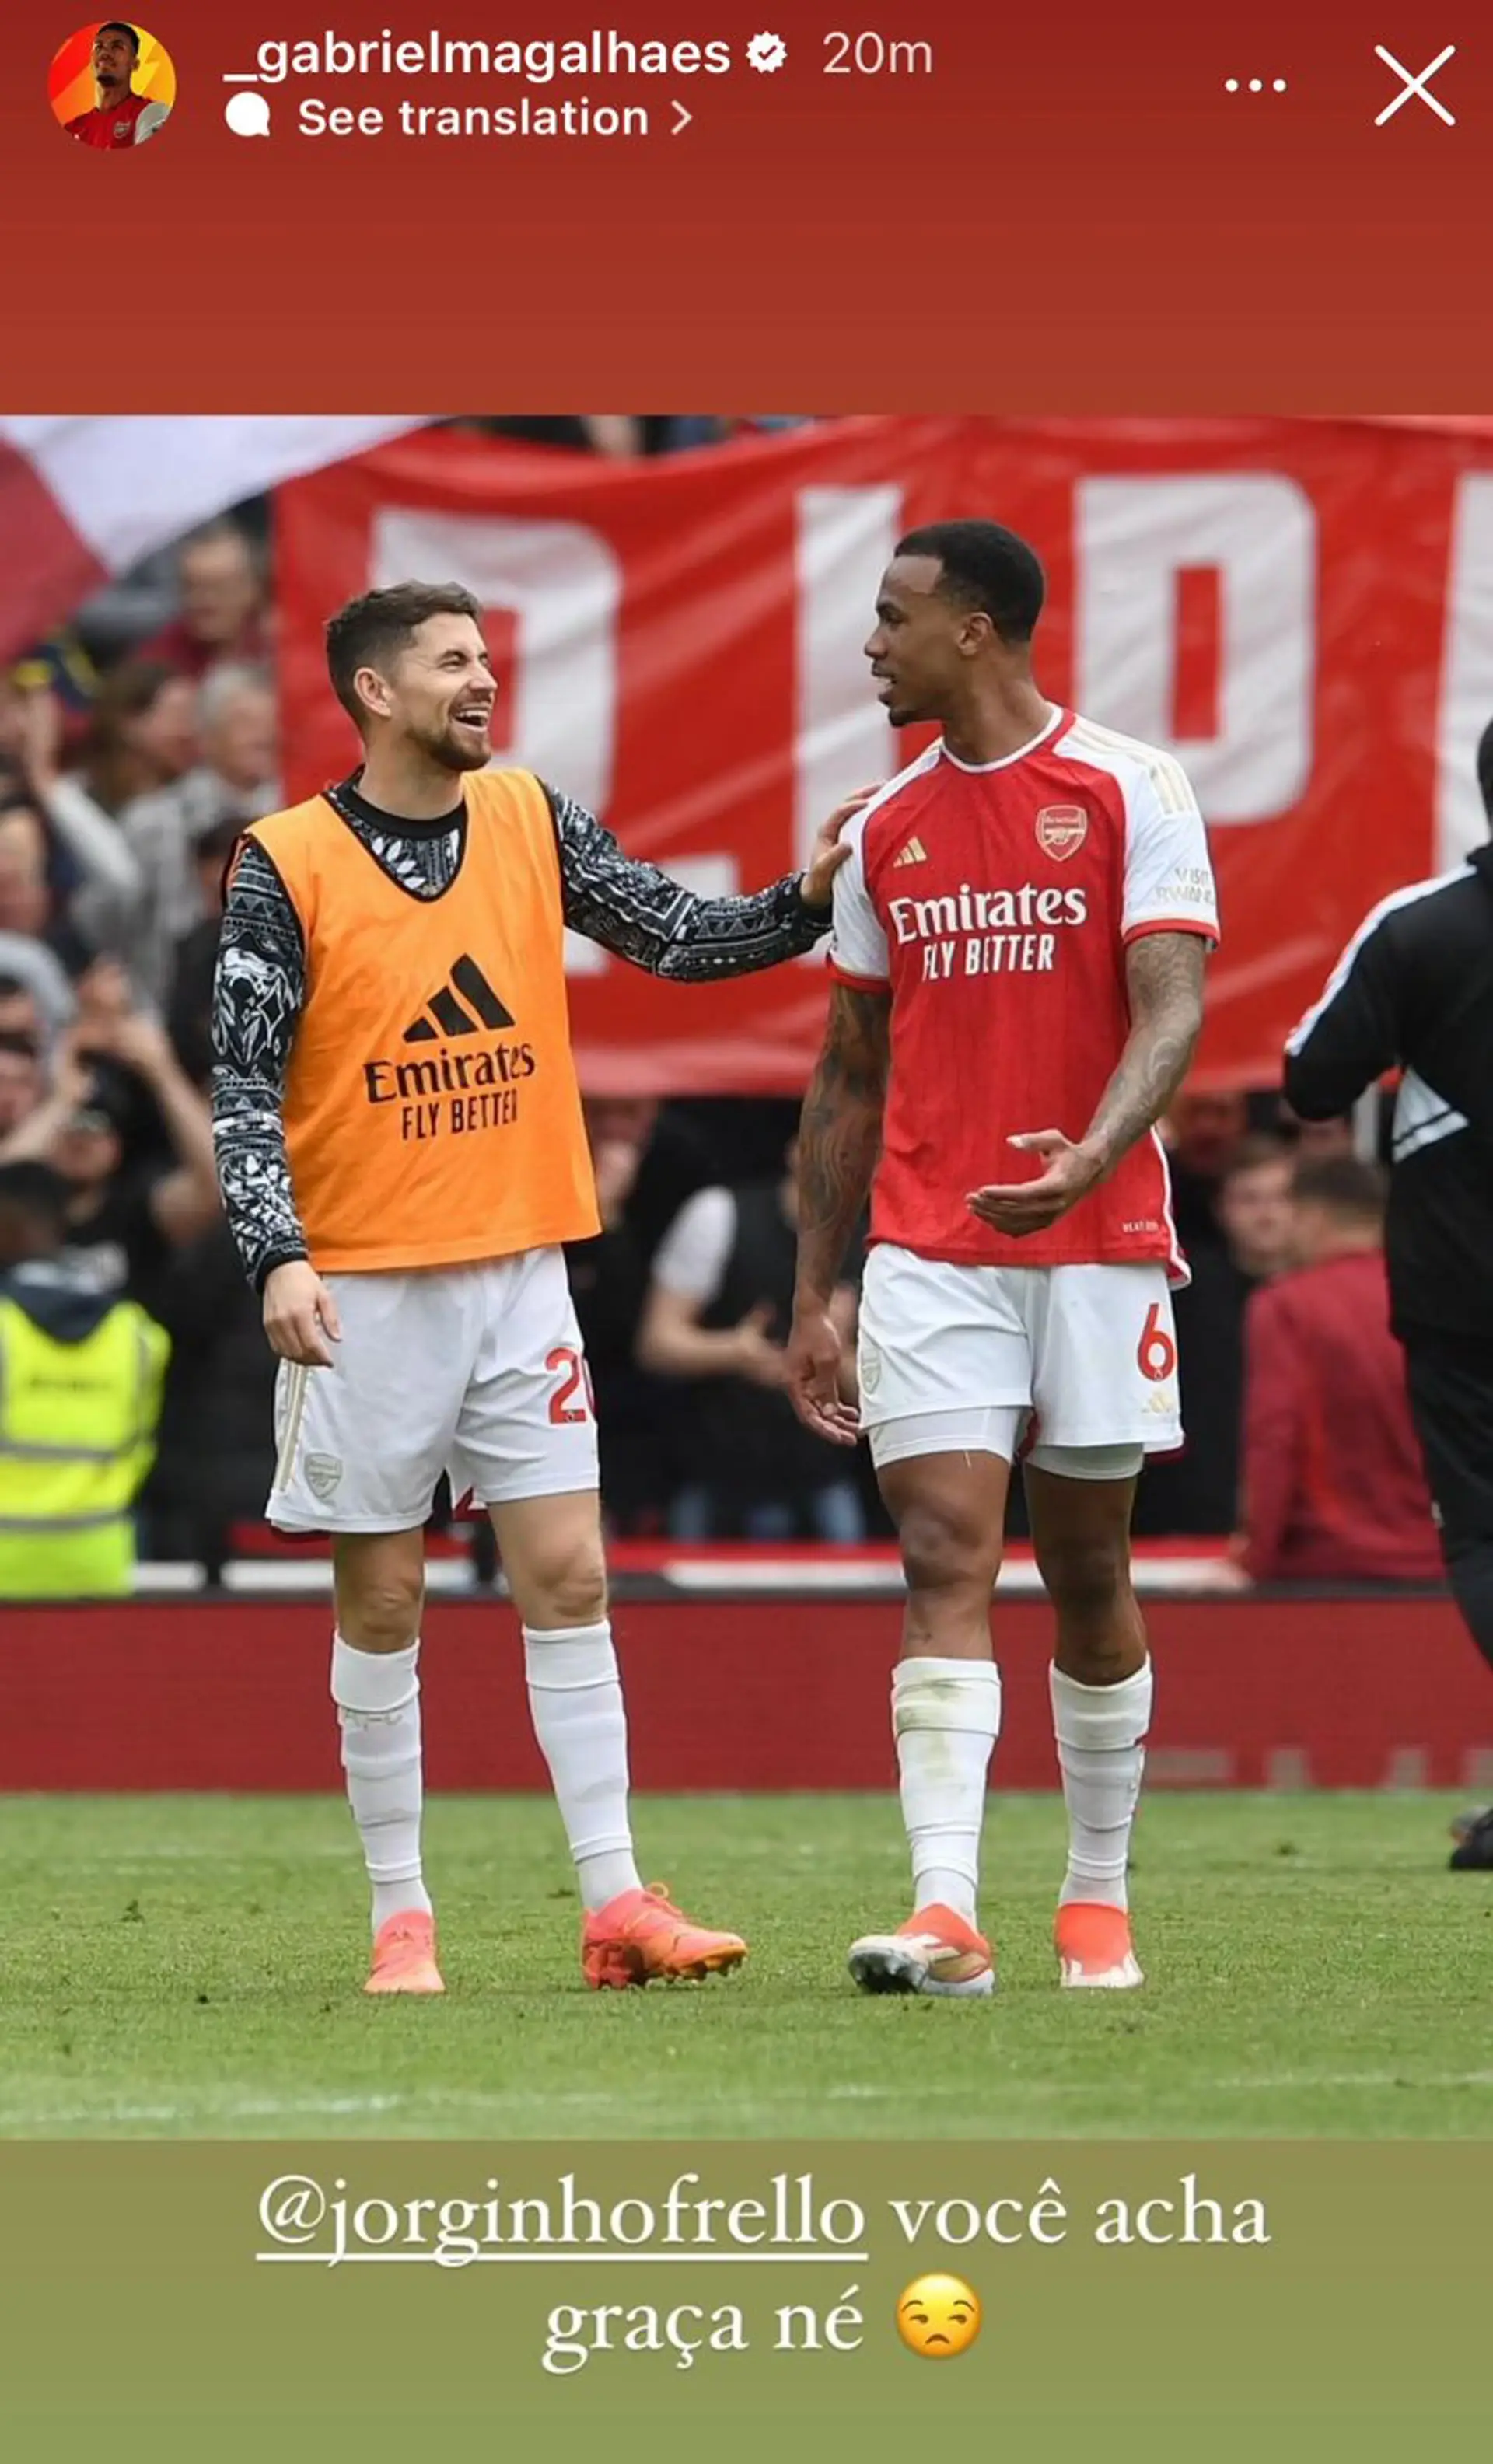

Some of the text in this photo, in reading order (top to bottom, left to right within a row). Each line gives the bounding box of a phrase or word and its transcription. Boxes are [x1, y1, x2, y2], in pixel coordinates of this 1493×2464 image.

[888, 882, 1087, 945] Emirates
[921, 933, 1055, 982] FLY BETTER
[363, 1042, 536, 1104] Emirates
[401, 1101, 440, 1141] FLY
[1136, 1302, 1176, 1382] 6
[545, 1347, 595, 1424] 2
